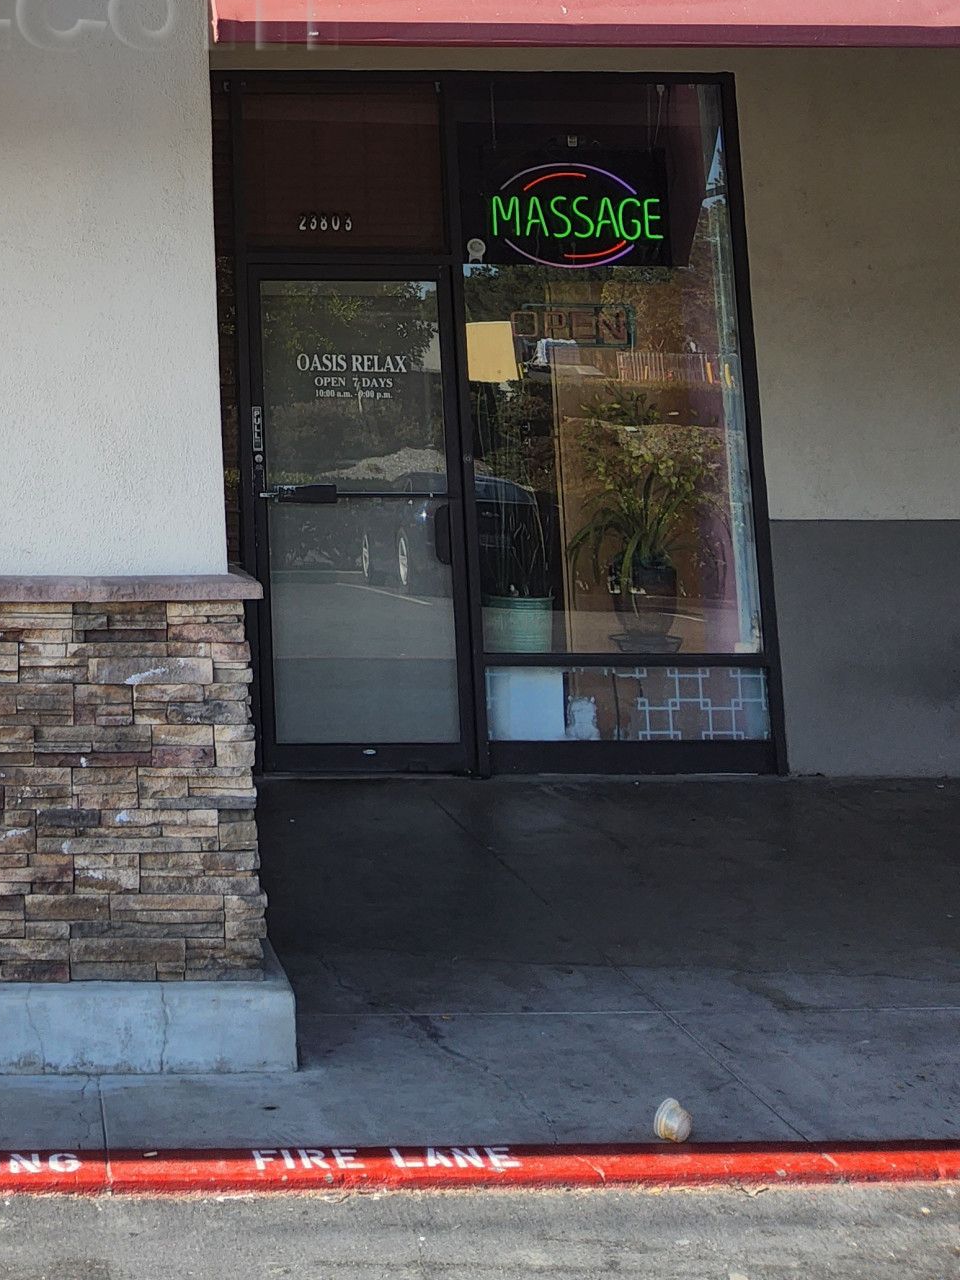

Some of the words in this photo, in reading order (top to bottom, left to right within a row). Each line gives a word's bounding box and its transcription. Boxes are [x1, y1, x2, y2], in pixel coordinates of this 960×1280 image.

[299, 215, 352, 231] 23803
[492, 195, 664, 240] MASSAGE
[511, 310, 628, 341] OPEN
[296, 353, 347, 372] OASIS
[351, 354, 407, 373] RELAX
[314, 376, 346, 387] OPEN
[352, 377, 359, 387] 7
[361, 377, 393, 388] DAYS
[315, 389, 335, 398] 10:00
[376, 391, 393, 400] p.m.
[254, 411, 260, 439] NO
[251, 1148, 365, 1170] FIRE
[389, 1146, 523, 1169] LANE
